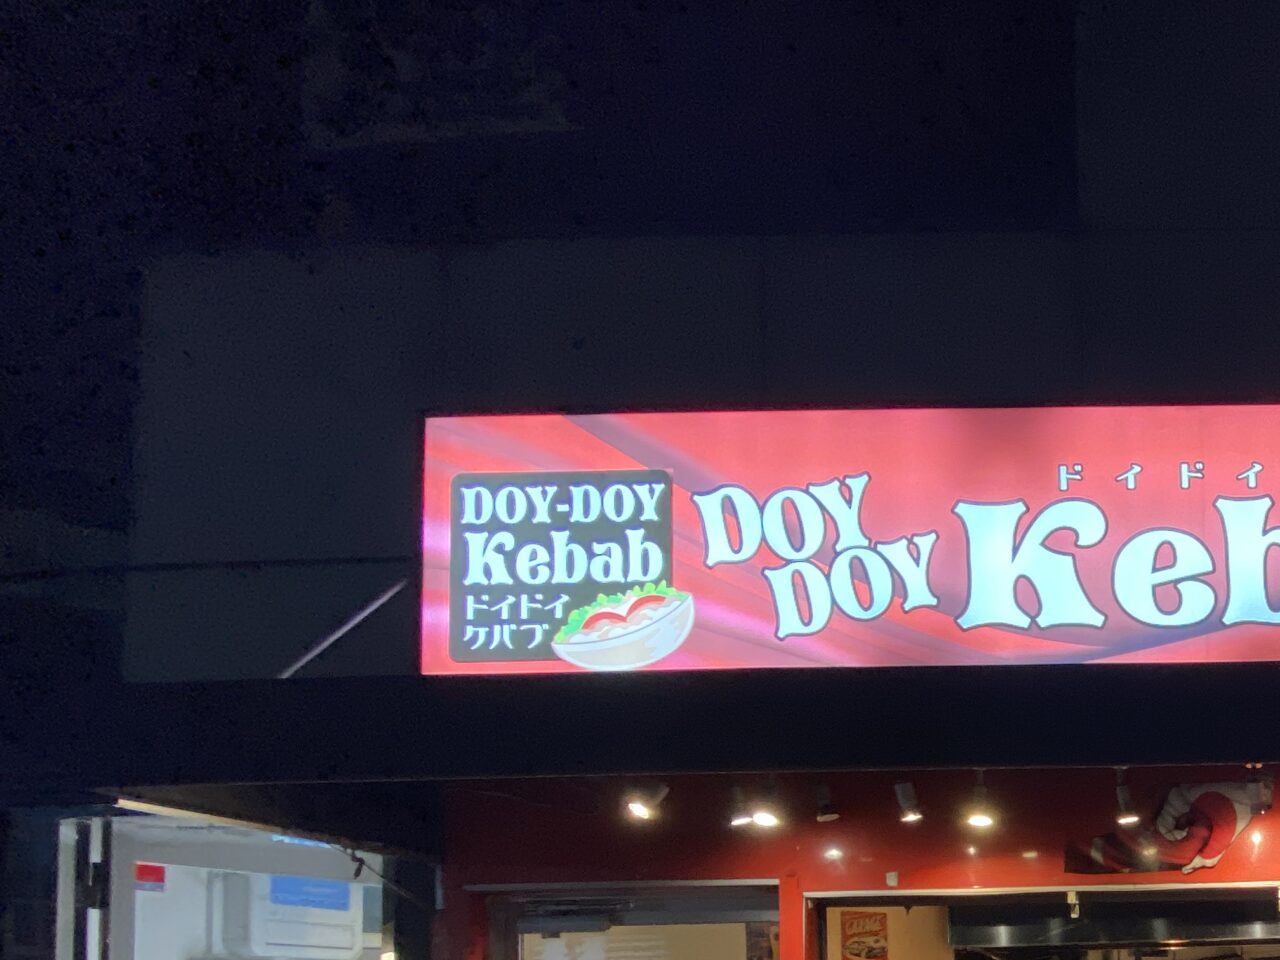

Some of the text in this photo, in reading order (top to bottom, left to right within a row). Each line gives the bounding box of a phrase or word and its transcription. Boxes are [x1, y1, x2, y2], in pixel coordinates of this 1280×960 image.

[460, 483, 665, 525] DOY-DOY
[692, 473, 870, 567] DOY
[462, 528, 664, 586] Kebab
[466, 594, 570, 620] ドイドイ
[763, 532, 939, 640] DOY
[463, 624, 549, 650] ケバブ
